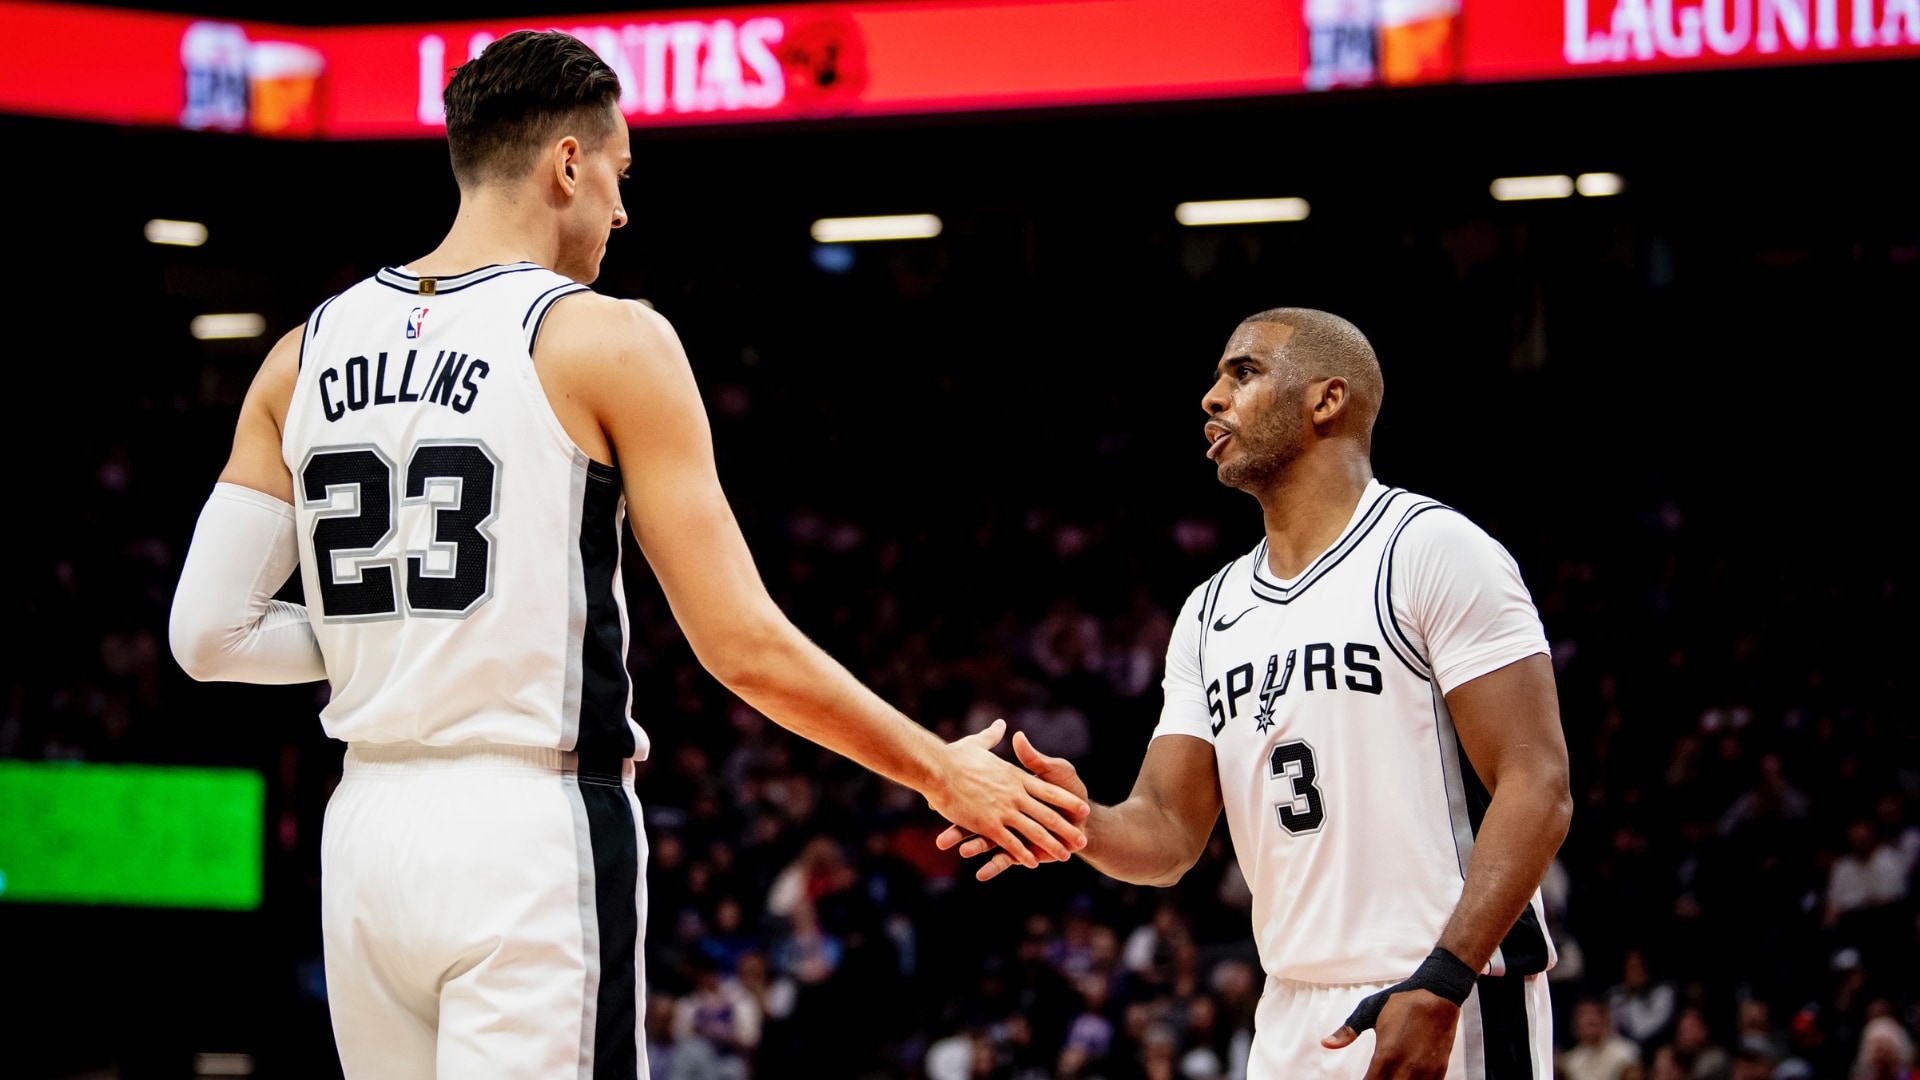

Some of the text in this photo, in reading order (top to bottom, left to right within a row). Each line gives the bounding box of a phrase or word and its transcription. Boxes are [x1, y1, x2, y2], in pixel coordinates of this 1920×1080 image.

[418, 16, 786, 125] LNITAS
[319, 350, 490, 422] COLLINS
[297, 438, 503, 624] 23
[1206, 642, 1383, 737] SPURS
[1268, 738, 1327, 837] 3
